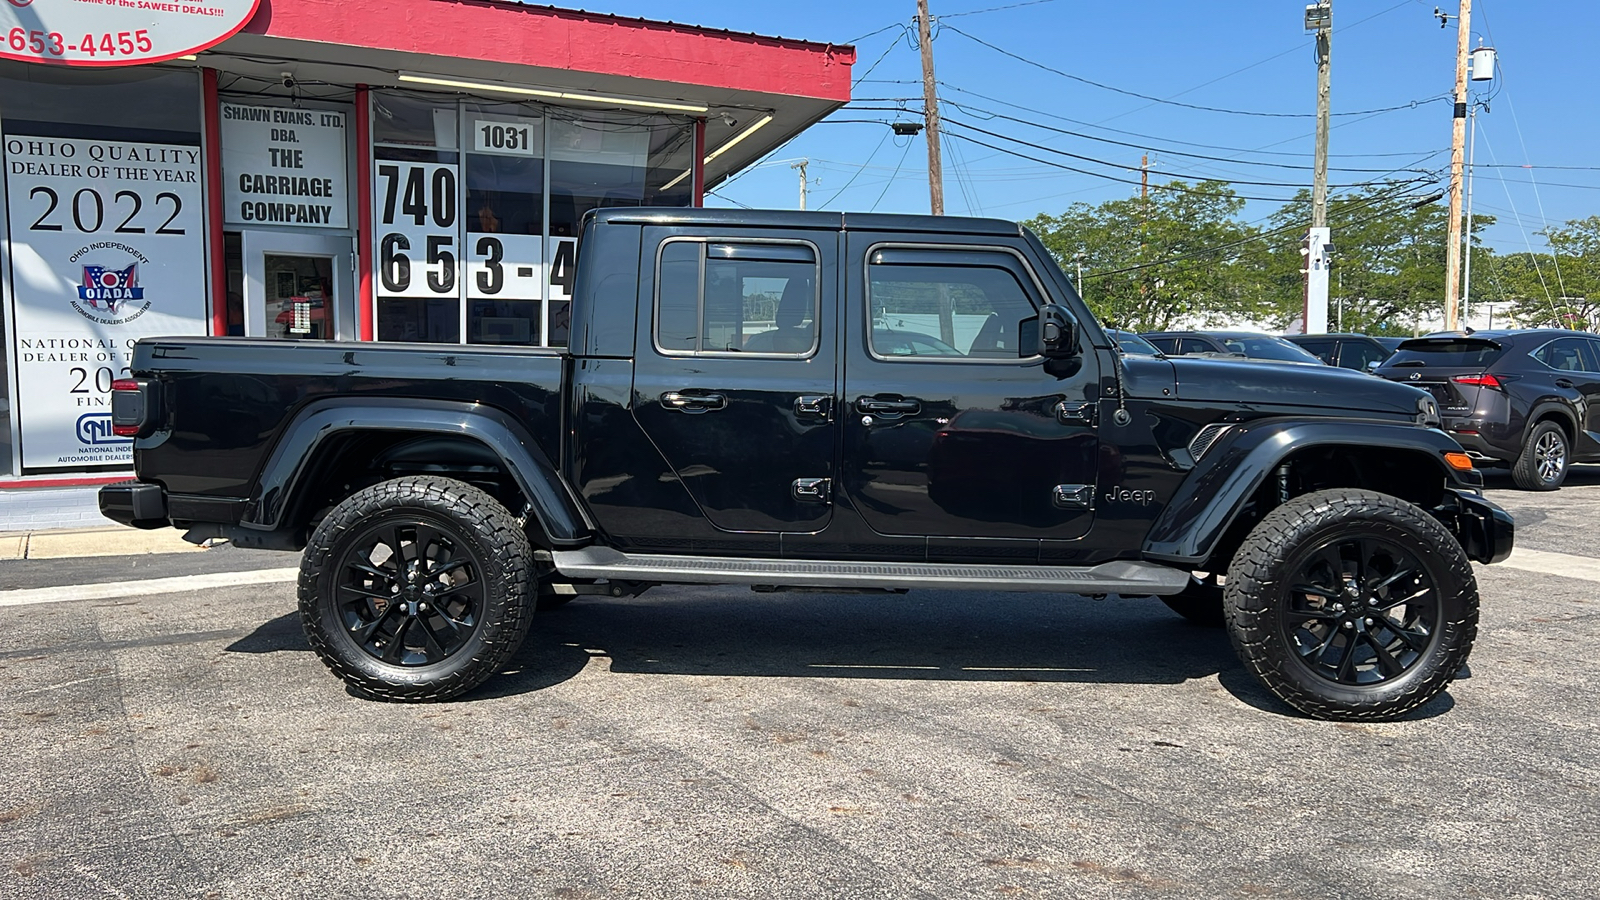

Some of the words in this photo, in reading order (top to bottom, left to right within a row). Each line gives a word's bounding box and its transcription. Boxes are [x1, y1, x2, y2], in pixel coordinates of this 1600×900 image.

[119, 0, 135, 8] the
[138, 0, 180, 12] SAWEET
[182, 5, 224, 17] DEALS!!!
[223, 106, 270, 122] SHAWN
[320, 114, 344, 129] LTD.
[271, 128, 299, 143] DBA.
[481, 125, 528, 150] 1031
[8, 140, 76, 157] OHIO
[89, 145, 199, 164] QUALITY
[268, 147, 303, 168] THE
[11, 161, 82, 178] DEALER
[87, 166, 109, 179] OF
[114, 167, 148, 180] THE
[153, 169, 197, 183] YEAR
[239, 173, 333, 198] CARRIAGE
[378, 165, 456, 228] 740
[29, 186, 186, 235] 2022
[241, 201, 332, 224] COMPANY
[69, 246, 89, 263] OHIO
[90, 241, 149, 264] INDEPENDENT
[86, 288, 133, 299] OIADA
[70, 300, 99, 324] AUTOMOBILE
[124, 300, 152, 324] ASSOCIATION
[21, 339, 118, 349] NATIONAL
[23, 353, 89, 362] DEALER
[96, 352, 116, 362] OF
[69, 366, 131, 394] 20
[58, 455, 102, 463] AUTOMOBILE
[1105, 485, 1156, 506] Jeep
